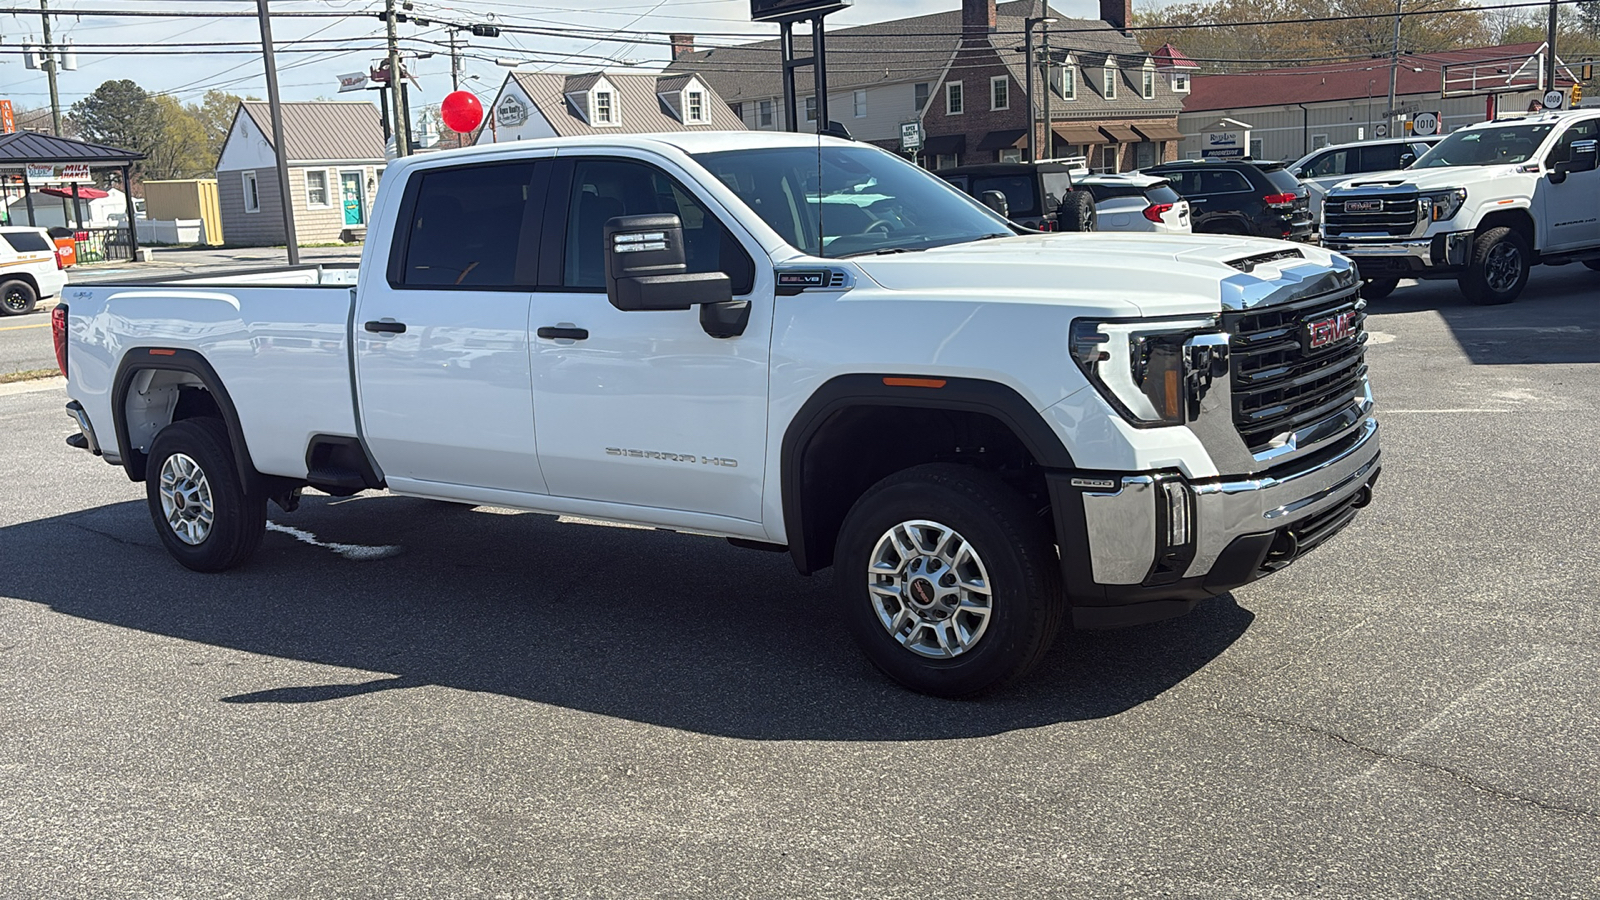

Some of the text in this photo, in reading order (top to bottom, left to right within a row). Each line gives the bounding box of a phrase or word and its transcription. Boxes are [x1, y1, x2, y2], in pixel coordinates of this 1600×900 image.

[1546, 95, 1560, 103] 1008
[1416, 119, 1435, 129] 1010
[65, 164, 89, 172] MILK
[1346, 201, 1379, 211] GMC
[1309, 310, 1356, 348] GMC
[605, 447, 738, 468] SIERRA HD
